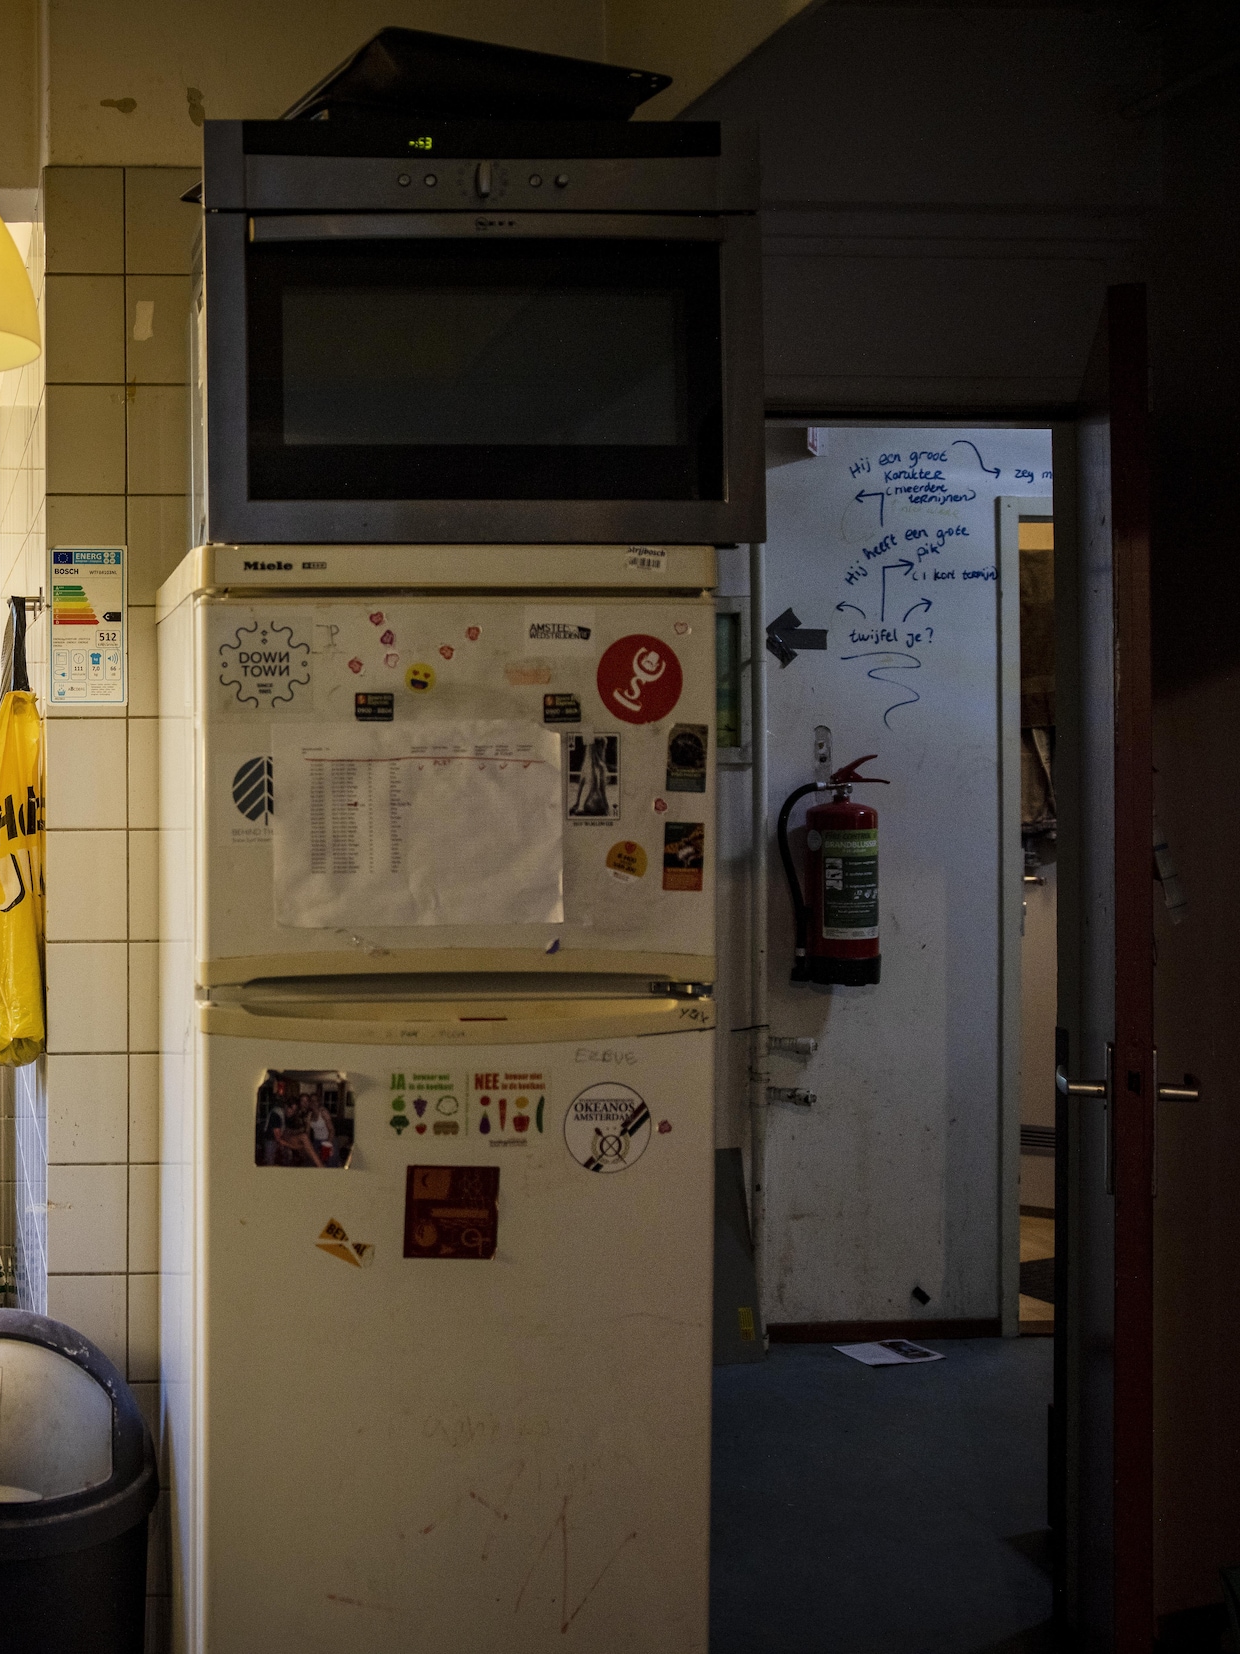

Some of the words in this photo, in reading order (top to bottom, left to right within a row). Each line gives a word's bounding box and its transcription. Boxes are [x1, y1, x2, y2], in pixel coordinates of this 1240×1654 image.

[849, 457, 871, 479] Hij
[909, 450, 948, 469] groot
[845, 560, 868, 586] Hij
[862, 534, 898, 560] heeft
[904, 529, 929, 541] een
[936, 525, 970, 547] grote
[917, 543, 941, 563] pik
[243, 561, 293, 570] Miele
[99, 632, 117, 642] 512
[849, 628, 898, 645] twijfel
[390, 1073, 406, 1090] JA
[474, 1073, 499, 1090] NEE
[573, 1102, 636, 1114] OKEANOS
